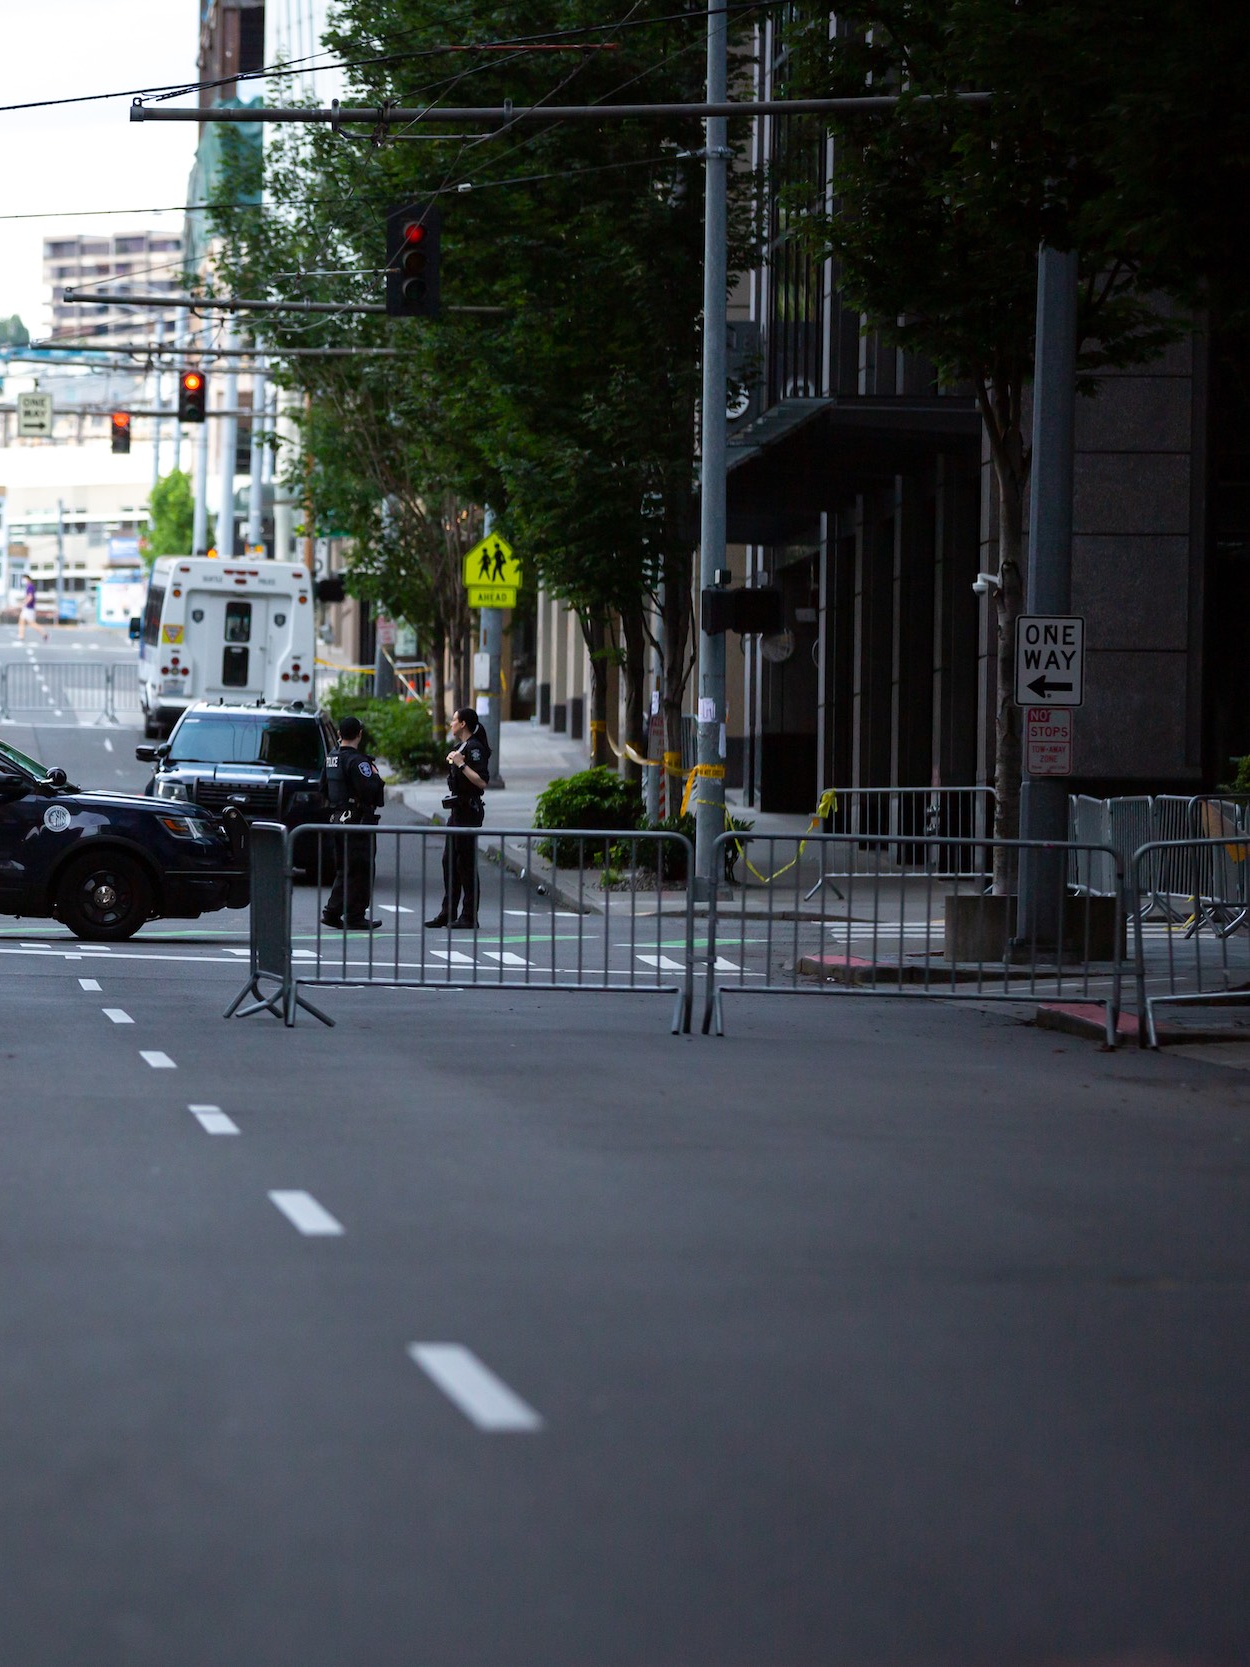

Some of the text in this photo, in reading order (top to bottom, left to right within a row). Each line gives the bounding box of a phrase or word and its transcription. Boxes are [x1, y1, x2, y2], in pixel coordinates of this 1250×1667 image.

[23, 398, 46, 407] ONE
[22, 410, 46, 418] WAY
[478, 592, 508, 603] AHEAD
[1026, 625, 1075, 646] ONE
[1024, 650, 1077, 670] WAY
[1030, 710, 1047, 722] NO
[1031, 726, 1068, 738] STOPS
[1039, 755, 1058, 763] ZONE
